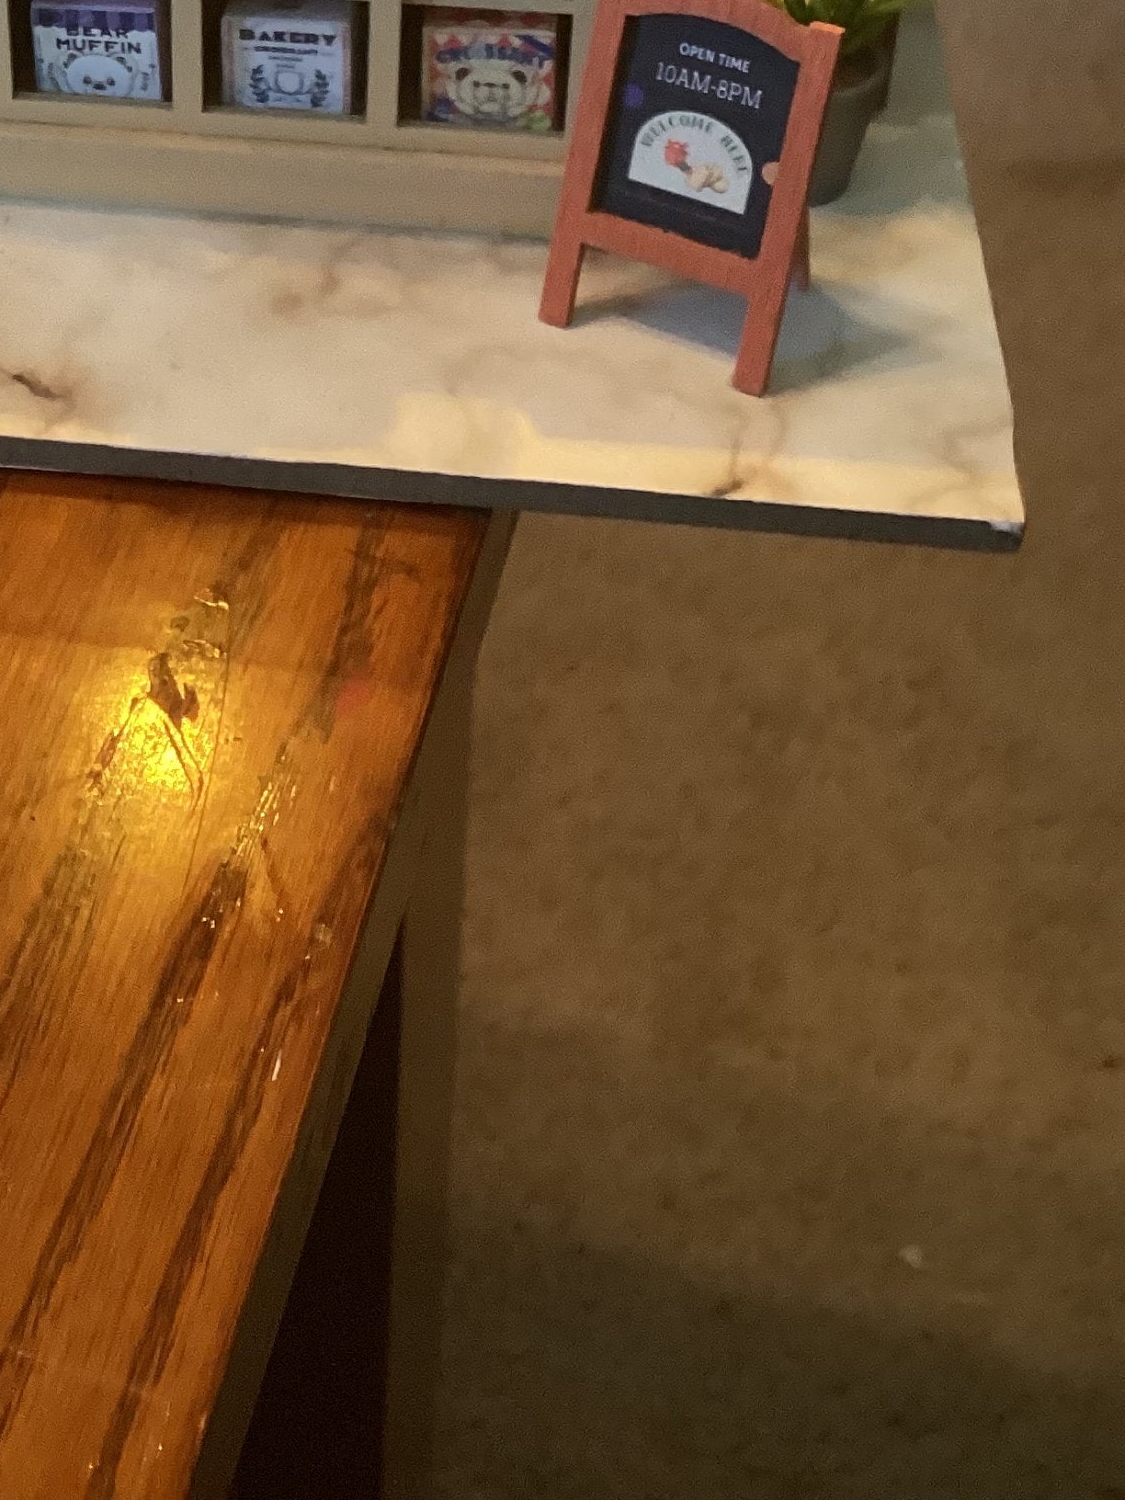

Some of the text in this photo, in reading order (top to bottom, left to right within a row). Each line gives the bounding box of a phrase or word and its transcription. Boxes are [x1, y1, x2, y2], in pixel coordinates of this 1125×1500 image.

[56, 37, 142, 55] MUFFIN
[238, 28, 337, 47] BAKERY
[678, 42, 751, 73] OPEN TIME
[655, 60, 764, 109] 10AM-8PM
[640, 114, 714, 148] WELCOME
